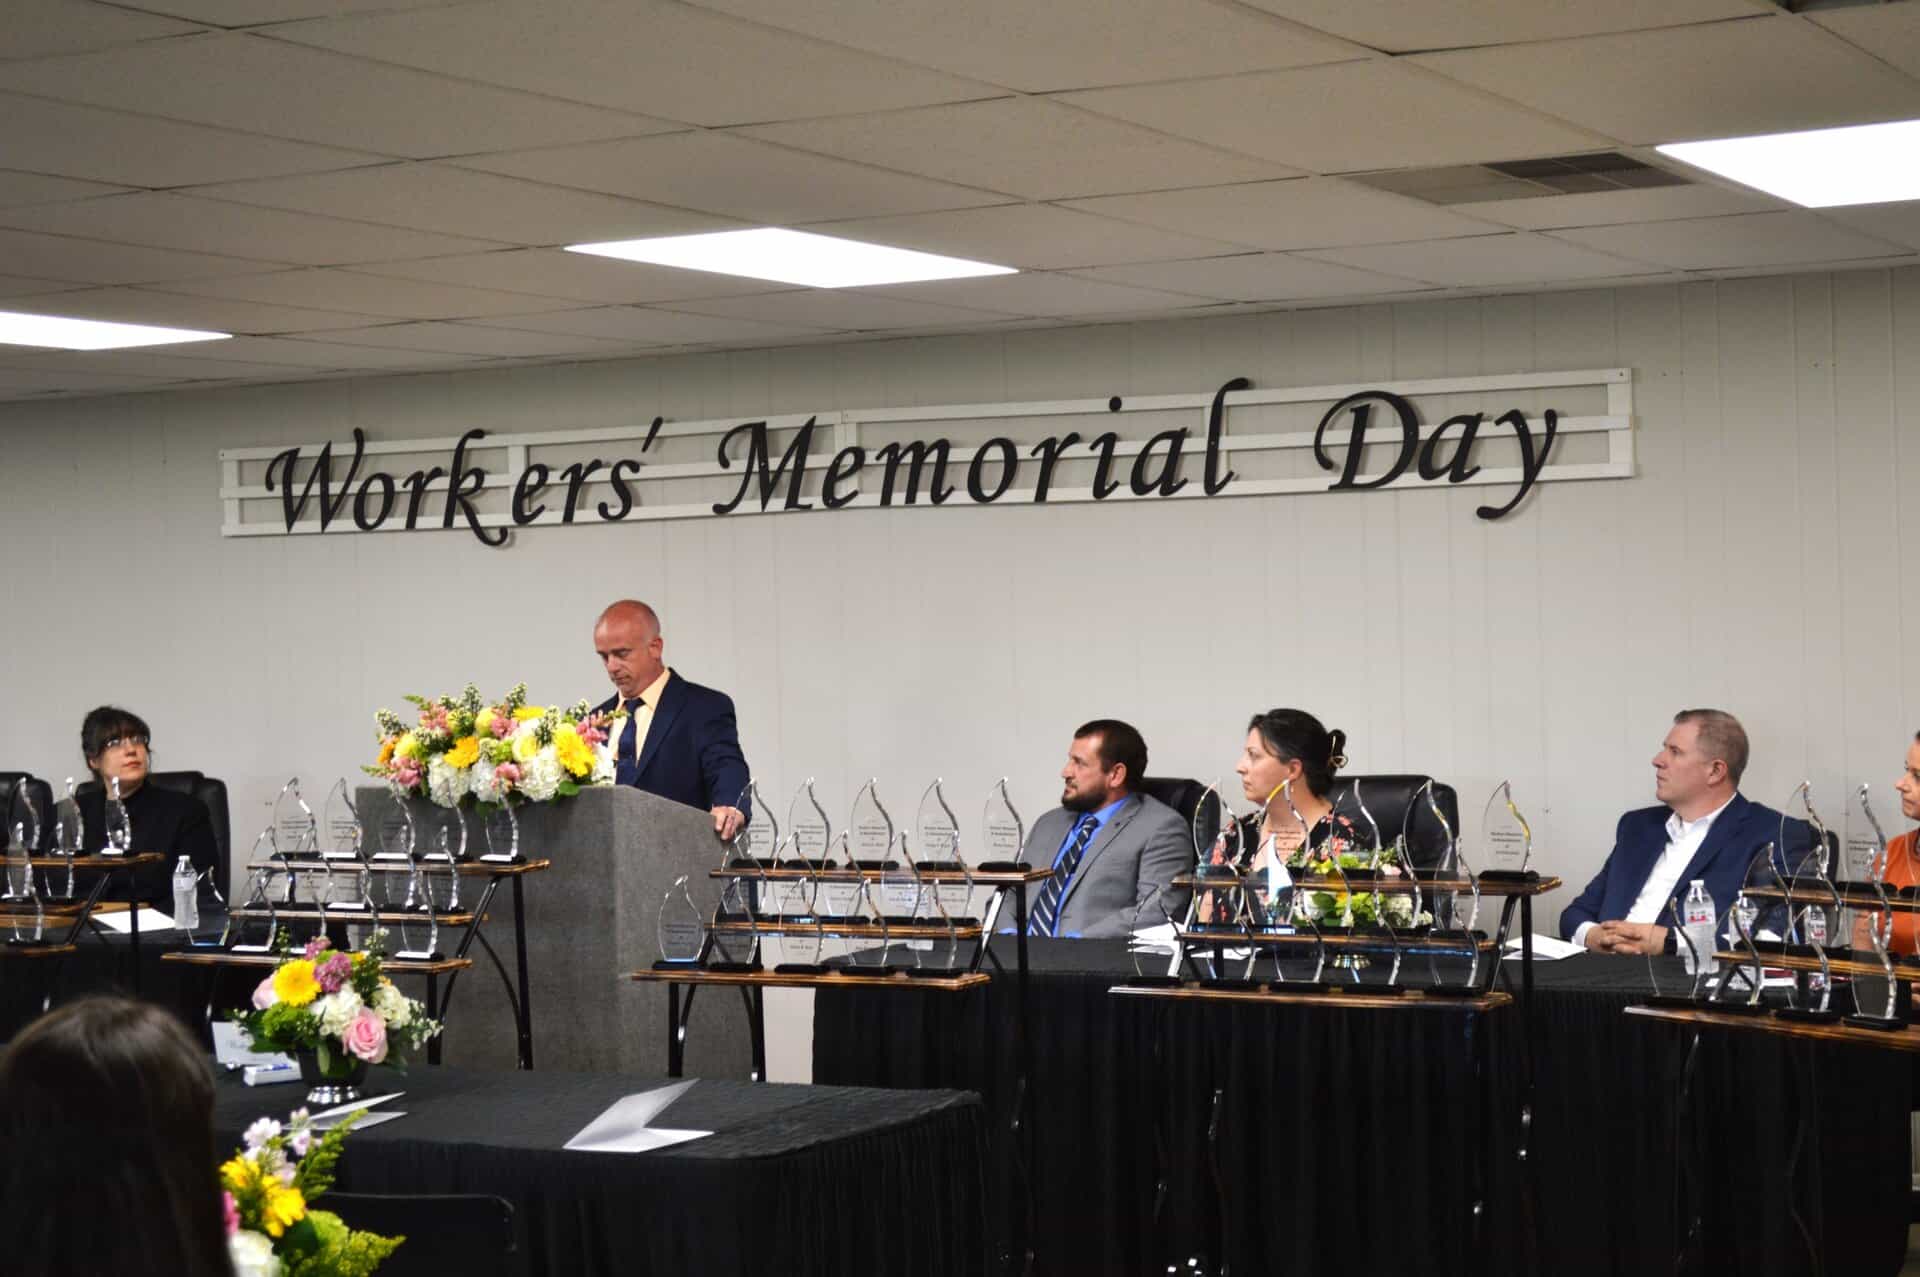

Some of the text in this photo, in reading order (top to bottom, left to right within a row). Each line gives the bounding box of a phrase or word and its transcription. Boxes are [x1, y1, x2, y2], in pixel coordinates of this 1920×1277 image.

[265, 378, 1557, 547] Workers' Memorial Day
